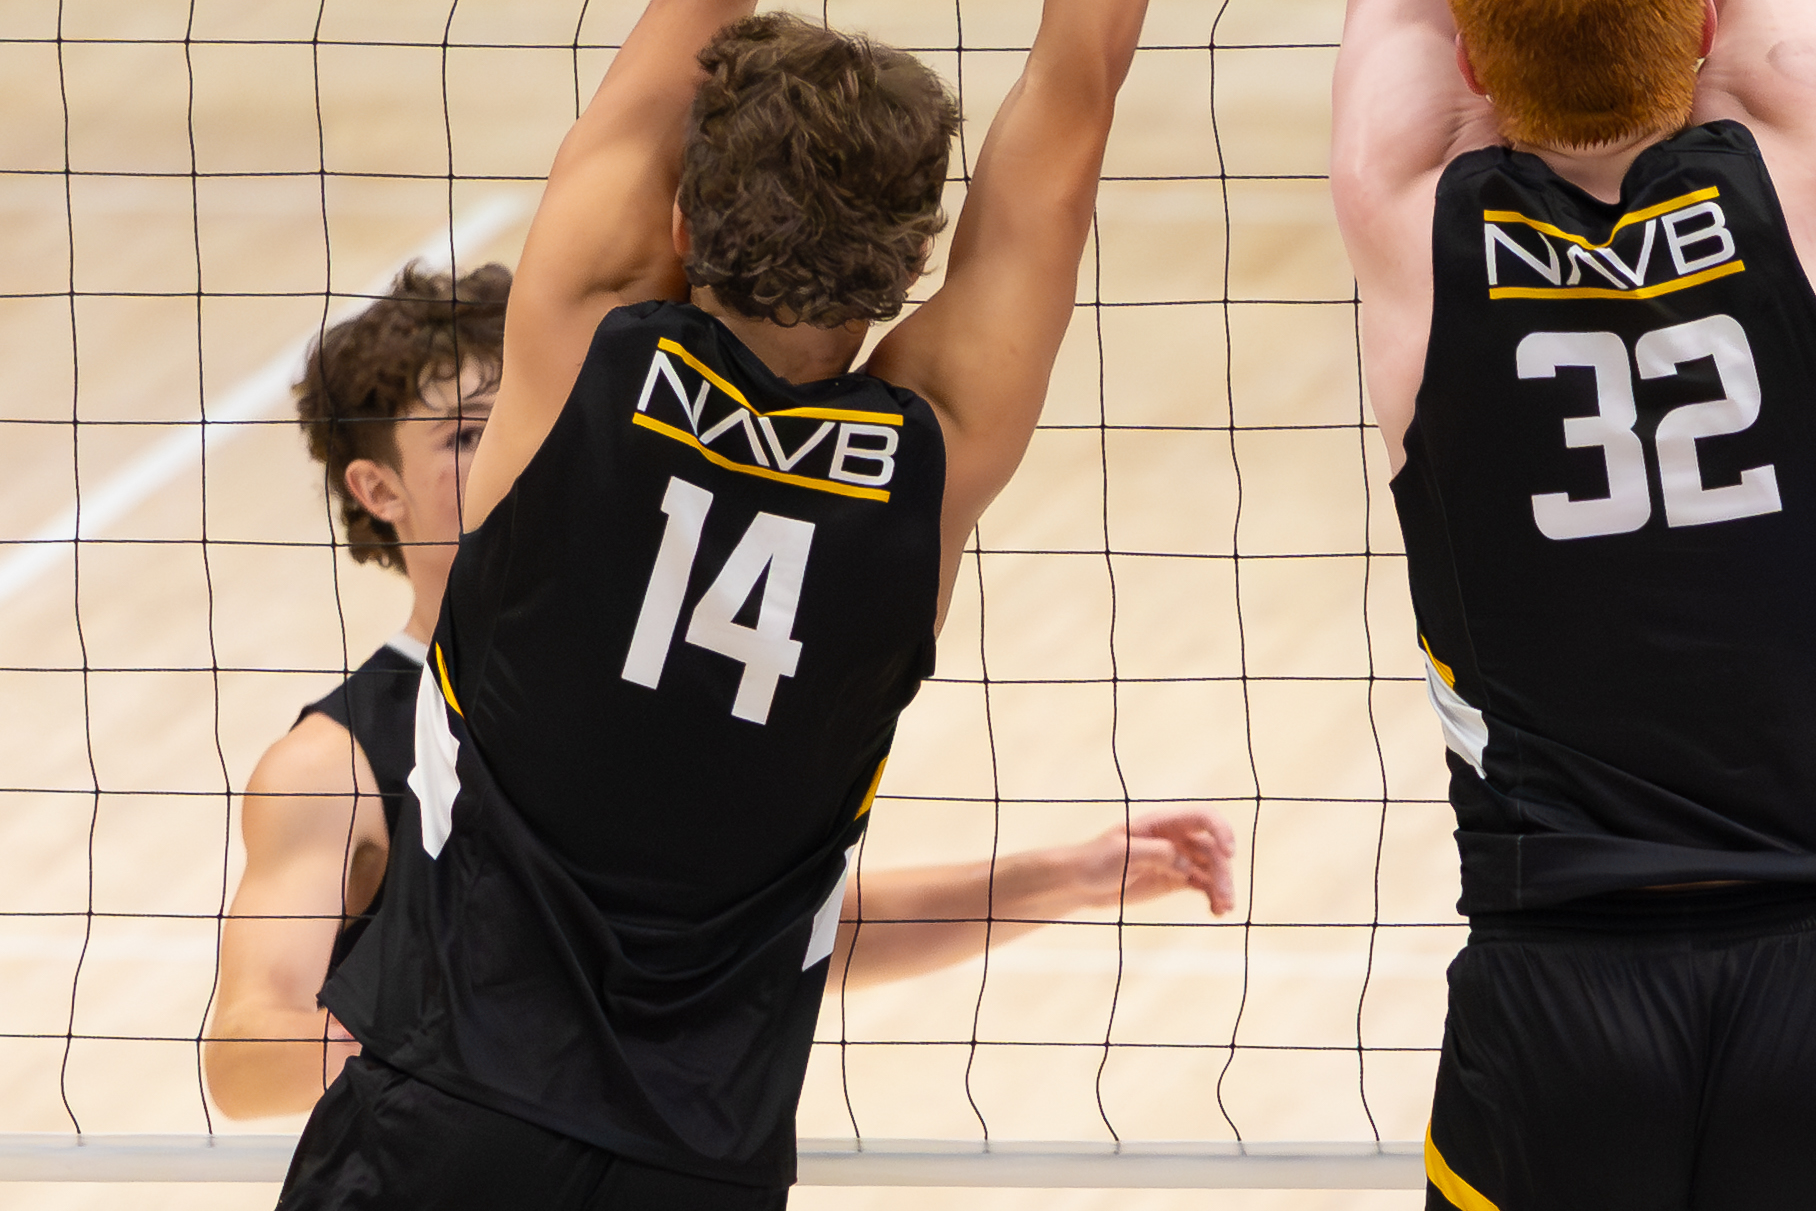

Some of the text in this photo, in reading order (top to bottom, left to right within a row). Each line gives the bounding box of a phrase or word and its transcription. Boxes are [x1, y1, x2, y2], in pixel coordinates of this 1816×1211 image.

[1483, 201, 1736, 289] NAVB
[637, 349, 900, 487] NAVB
[1515, 313, 1783, 541] 32
[620, 475, 816, 726] 14
